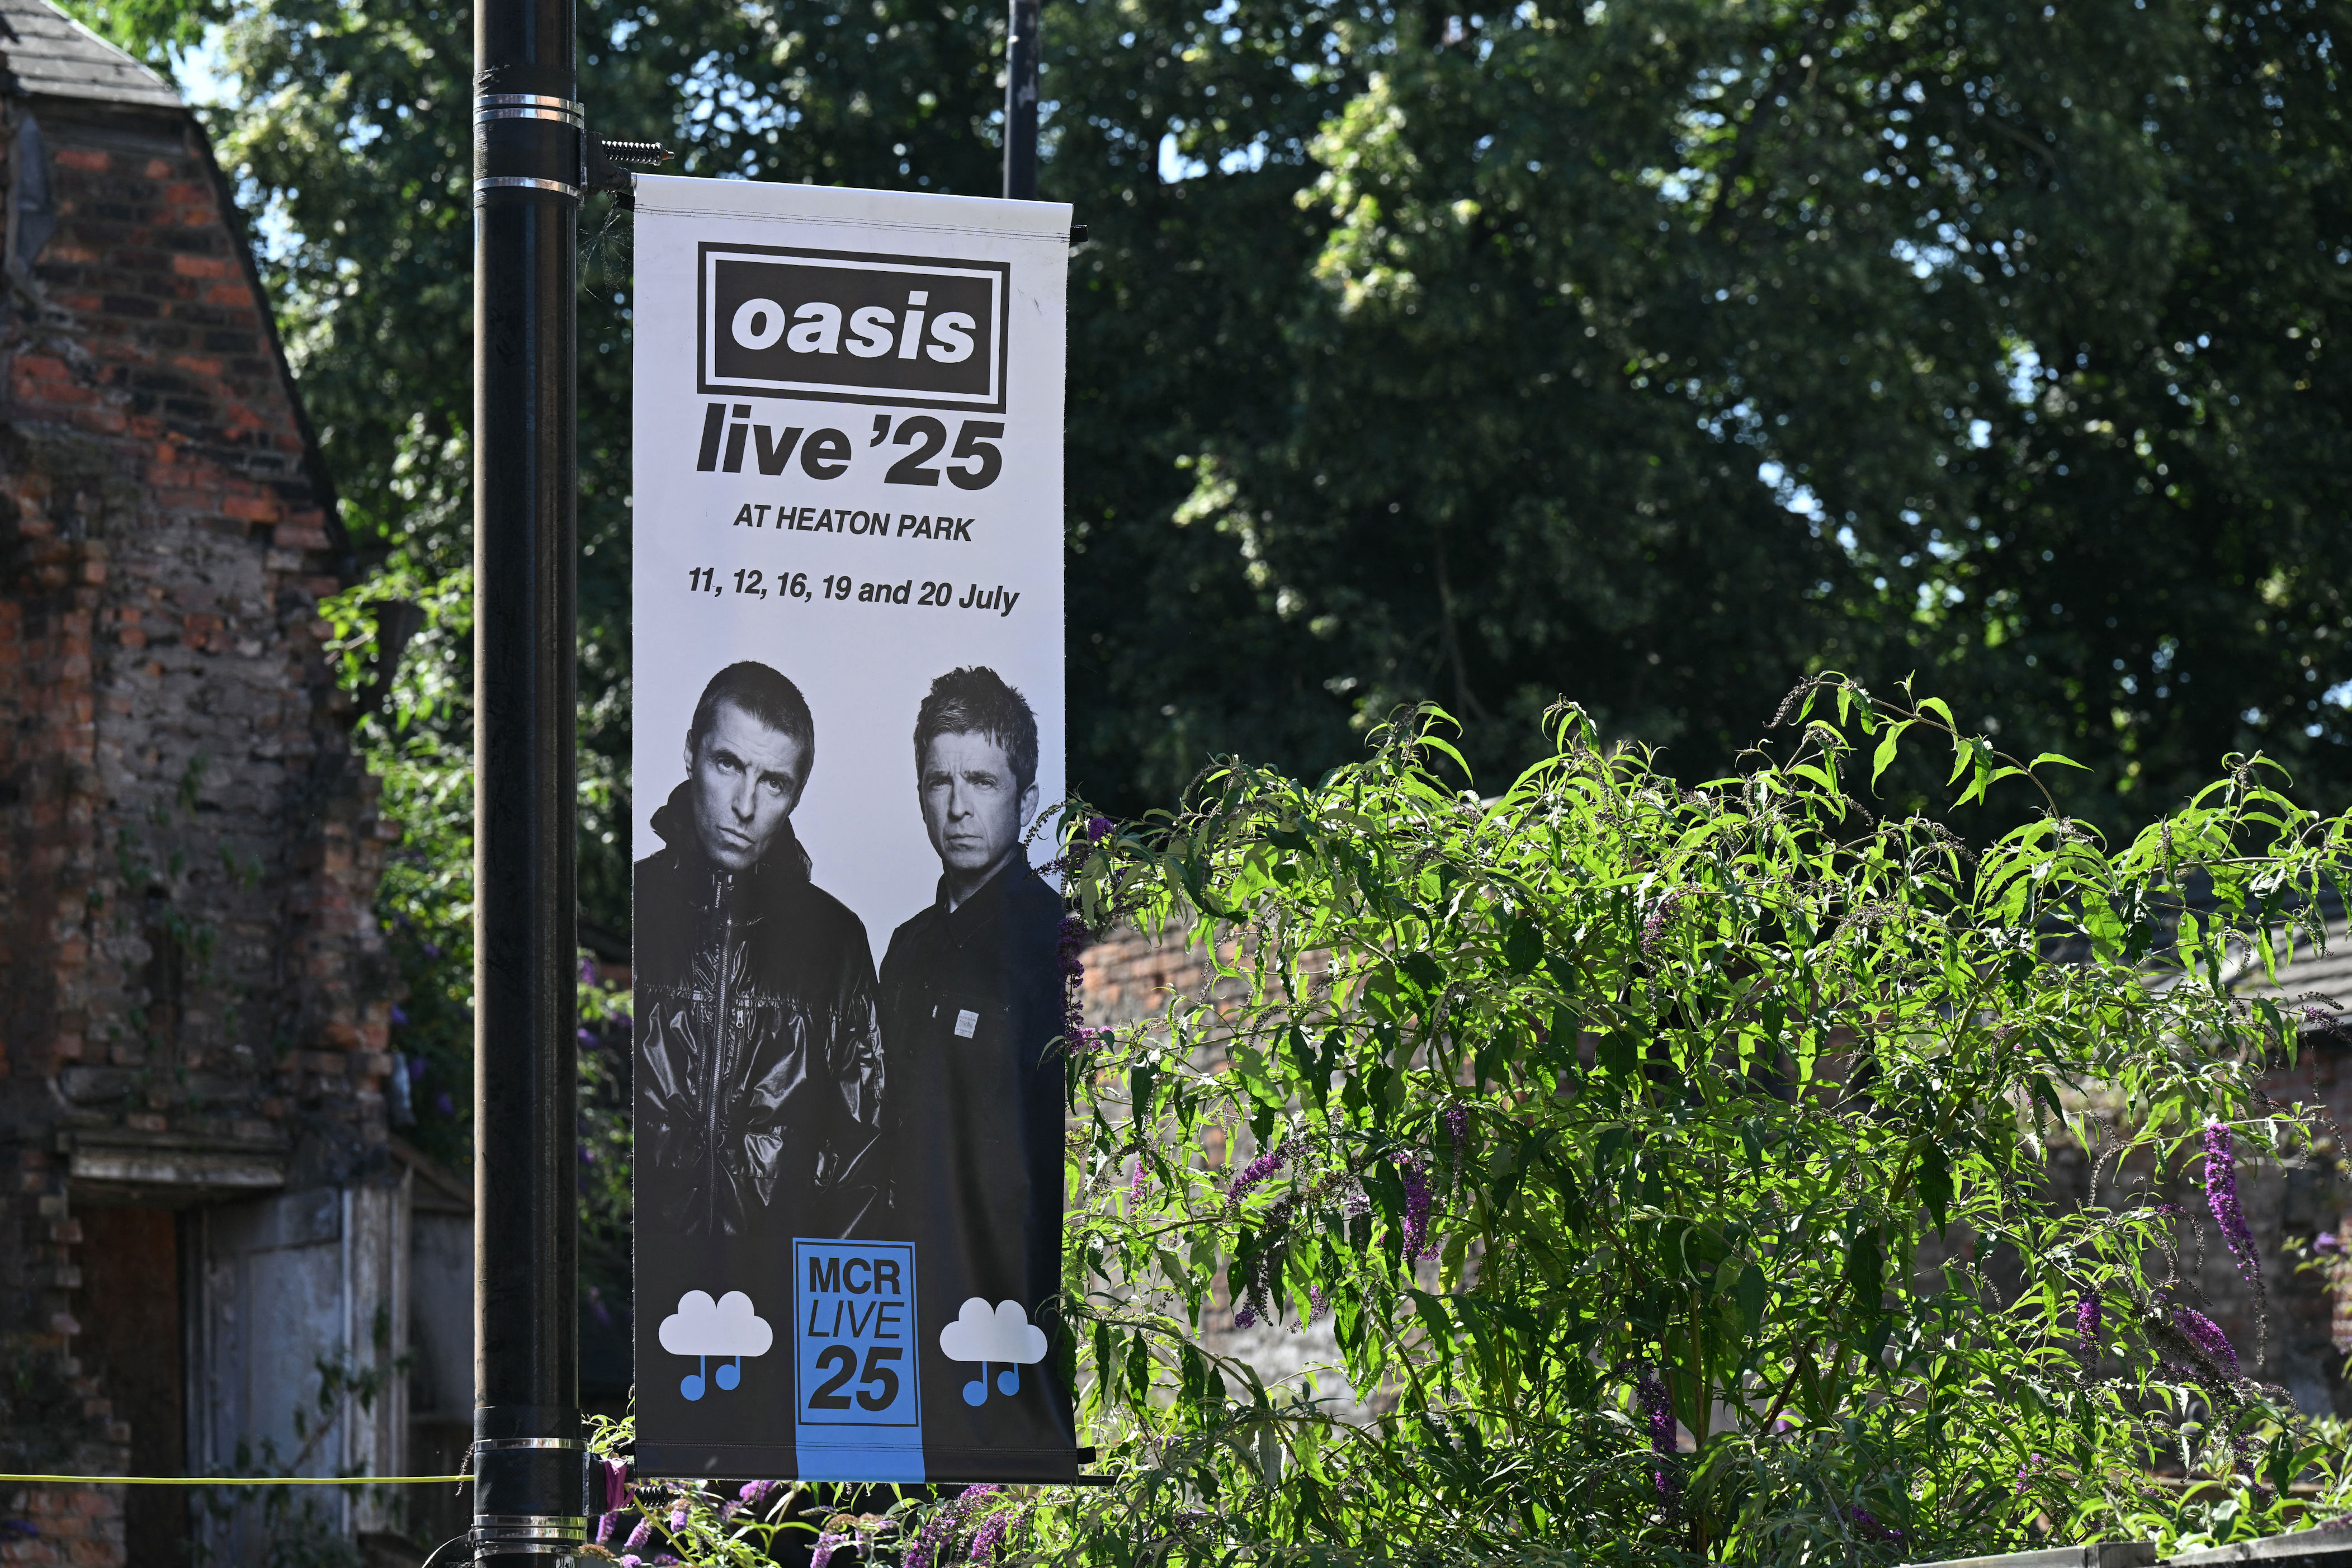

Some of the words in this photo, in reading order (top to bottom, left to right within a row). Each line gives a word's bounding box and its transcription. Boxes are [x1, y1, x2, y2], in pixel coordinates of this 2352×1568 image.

[732, 291, 976, 363] oasis
[697, 403, 851, 480] live
[870, 414, 1005, 490] '25
[733, 504, 771, 527] AT
[776, 507, 890, 536] HEATON
[897, 514, 975, 541] PARK
[689, 568, 722, 597] 11,
[734, 569, 767, 599] 12,
[778, 572, 811, 603] 16,
[823, 575, 851, 600] 19
[858, 580, 912, 604] and
[918, 582, 952, 606] 20
[959, 584, 1020, 617] July
[810, 1257, 901, 1295] MCR
[808, 1300, 904, 1339] LIVE
[808, 1345, 903, 1411] 25
